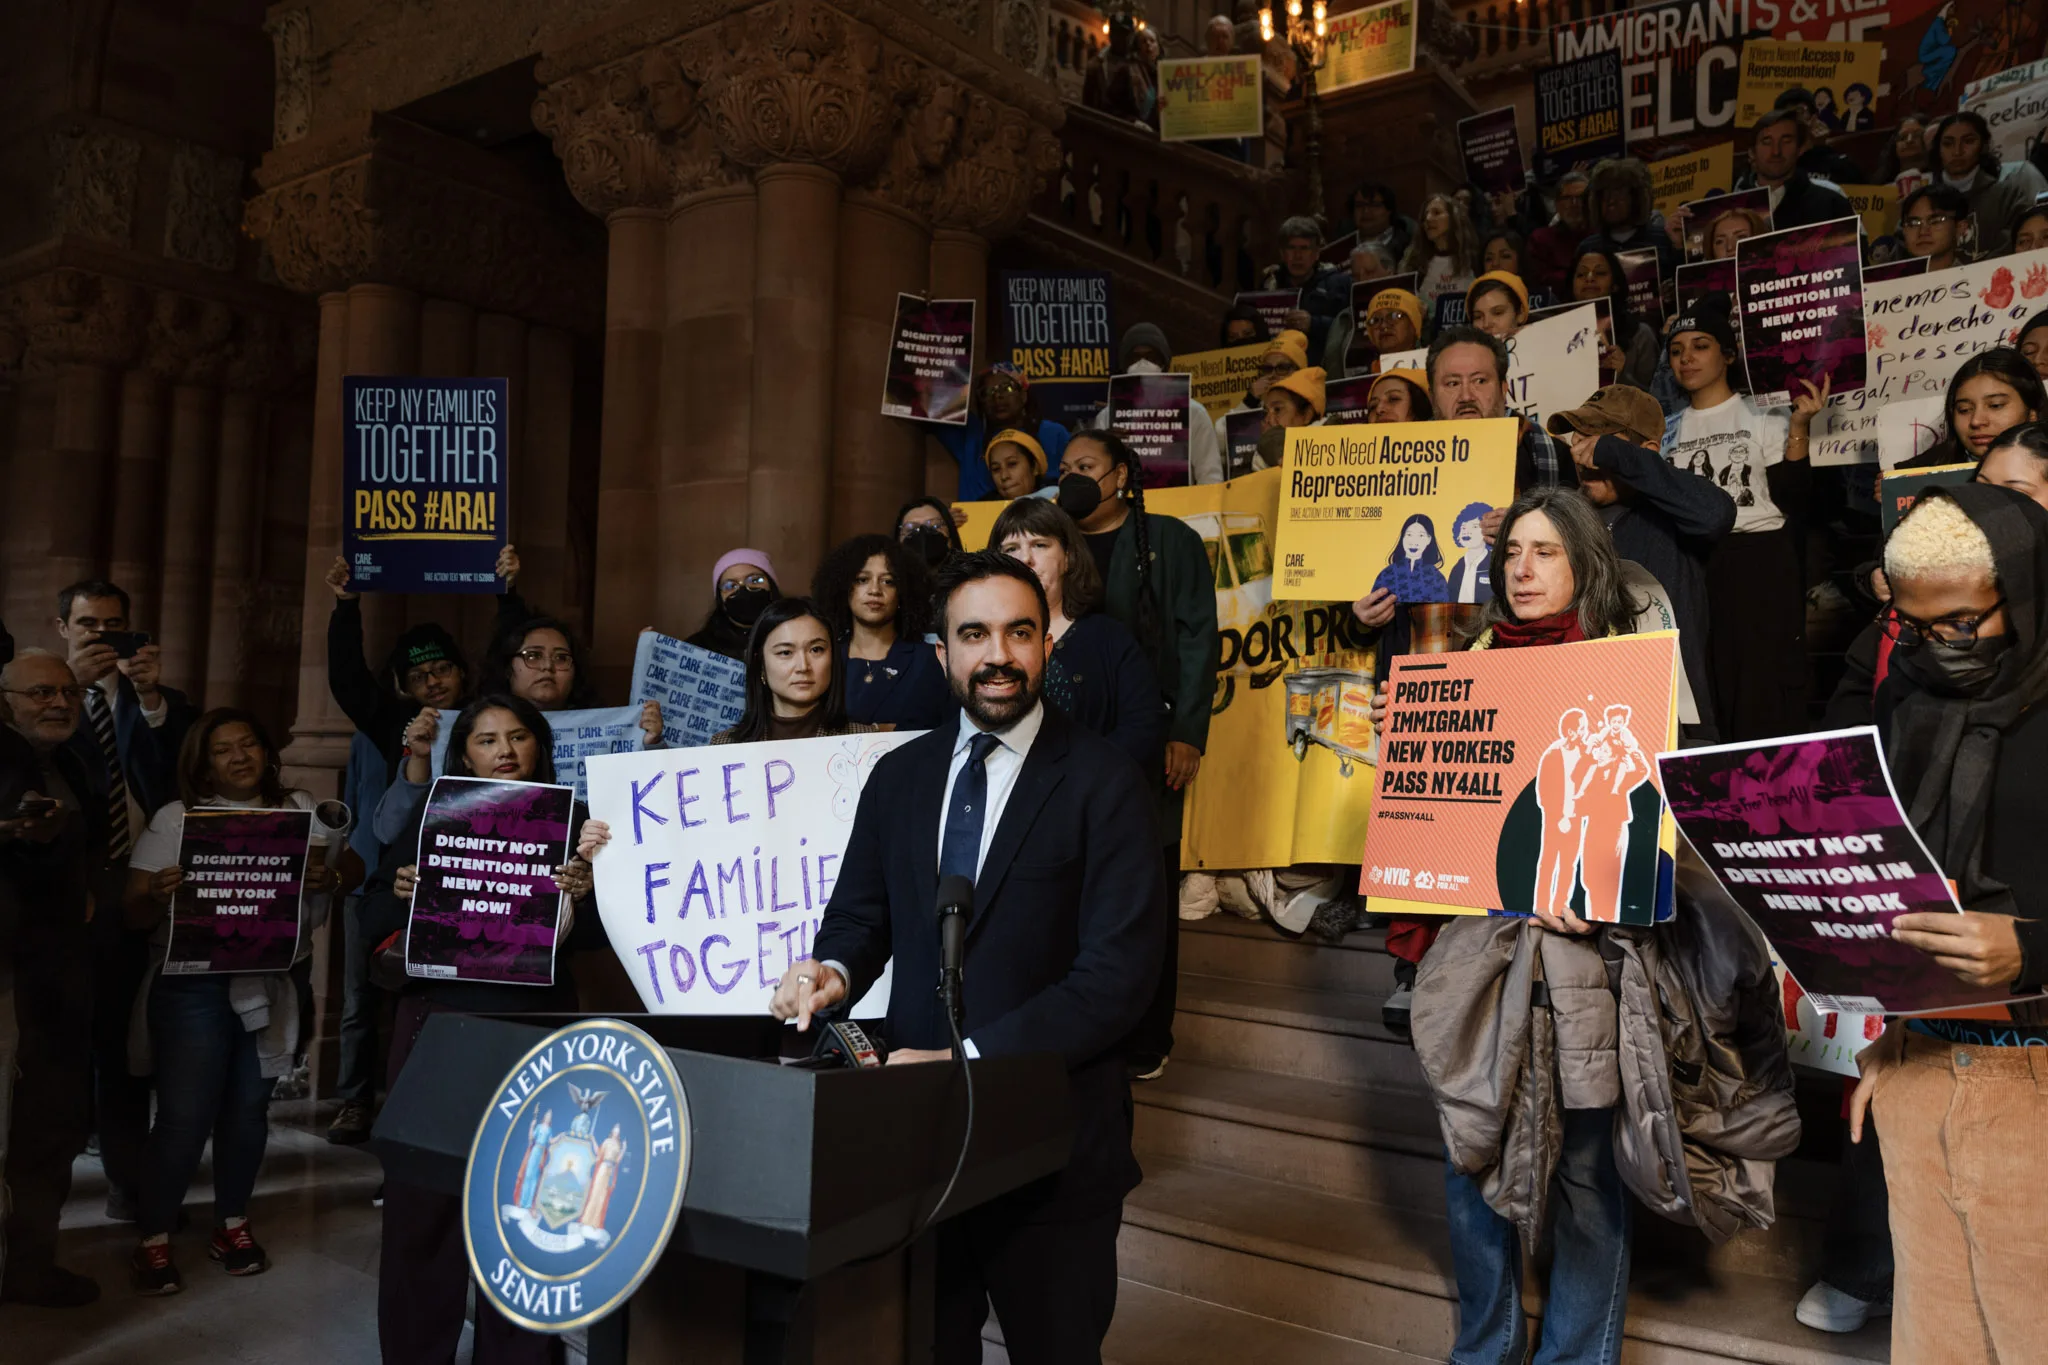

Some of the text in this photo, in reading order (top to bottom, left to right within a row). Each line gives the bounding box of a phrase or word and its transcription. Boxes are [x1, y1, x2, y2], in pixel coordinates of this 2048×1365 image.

[1801, 47, 1842, 63] Access
[1843, 49, 1856, 63] to
[1541, 74, 1619, 123] TOGETHER
[1542, 107, 1619, 149] PASS #ARA!
[1664, 157, 1710, 178] Access to
[1870, 194, 1884, 210] to
[1008, 277, 1106, 303] KEEP NY FAMILIES
[1749, 268, 1844, 295] DIGNITY NOT
[1748, 285, 1850, 313] DETENTION IN
[1009, 303, 1110, 344] TOGETHER
[1762, 305, 1838, 328] NEW YORK
[1898, 304, 2029, 340] derecho a
[901, 329, 964, 343] DIGNITY NOT
[1781, 326, 1822, 342] NOW!
[897, 340, 966, 356] DETENTION IN
[904, 354, 957, 367] NEW YORK
[1012, 347, 1110, 377] PASS #ARA!
[915, 367, 944, 378] NOW!
[355, 388, 497, 424] KEEP NY FAMILIES
[1116, 409, 1180, 418] DIGNITY NOT
[1171, 422, 1183, 430] IN
[1145, 434, 1174, 443] YORK
[355, 424, 498, 484] TOGETHER
[1294, 435, 1470, 467] NYers Need Access to
[1291, 467, 1439, 503] Representation!
[355, 489, 496, 530] PASS #ARA!
[1291, 507, 1301, 518] TAKE
[1323, 506, 1334, 518] TEXT
[1361, 506, 1383, 518] 52886
[354, 552, 373, 565] CARE
[1285, 553, 1305, 567] CARE
[646, 664, 669, 683] CARE
[680, 655, 702, 674] CARE
[669, 689, 693, 709] CARE
[697, 680, 720, 699] CARE
[1395, 679, 1474, 703] PROTECT
[720, 704, 744, 721] CARE
[1391, 709, 1497, 733] IMMIGRANT
[687, 714, 711, 733] CARE
[551, 744, 575, 758] CARE
[1387, 740, 1515, 764] NEW YORKERS
[1382, 771, 1502, 796] PASS NY4ALL
[631, 759, 796, 846] KEEP
[1378, 811, 1435, 821] #PASSNY4ALL
[435, 834, 548, 856] DIGNITY NOT
[1712, 833, 1886, 859] DIGNITY NOT
[192, 854, 291, 866] DIGNITY NOT
[428, 854, 551, 876] DETENTION IN
[185, 871, 293, 882] DETENTION IN
[1383, 867, 1411, 887] NYIC
[1438, 873, 1470, 884] NEW YORK
[1723, 861, 1917, 886] DETENTION IN
[197, 888, 277, 899] NEW YORK
[442, 876, 533, 897] NEW YORK
[1437, 882, 1460, 891] FOR ALL
[216, 905, 259, 915] NOW!
[461, 899, 512, 915] NOW!
[1762, 892, 1909, 914] NEW YORK
[1810, 921, 1891, 940] NOW!
[498, 1033, 675, 1157] NEW YORK STATE
[490, 1257, 583, 1317] SENATE
